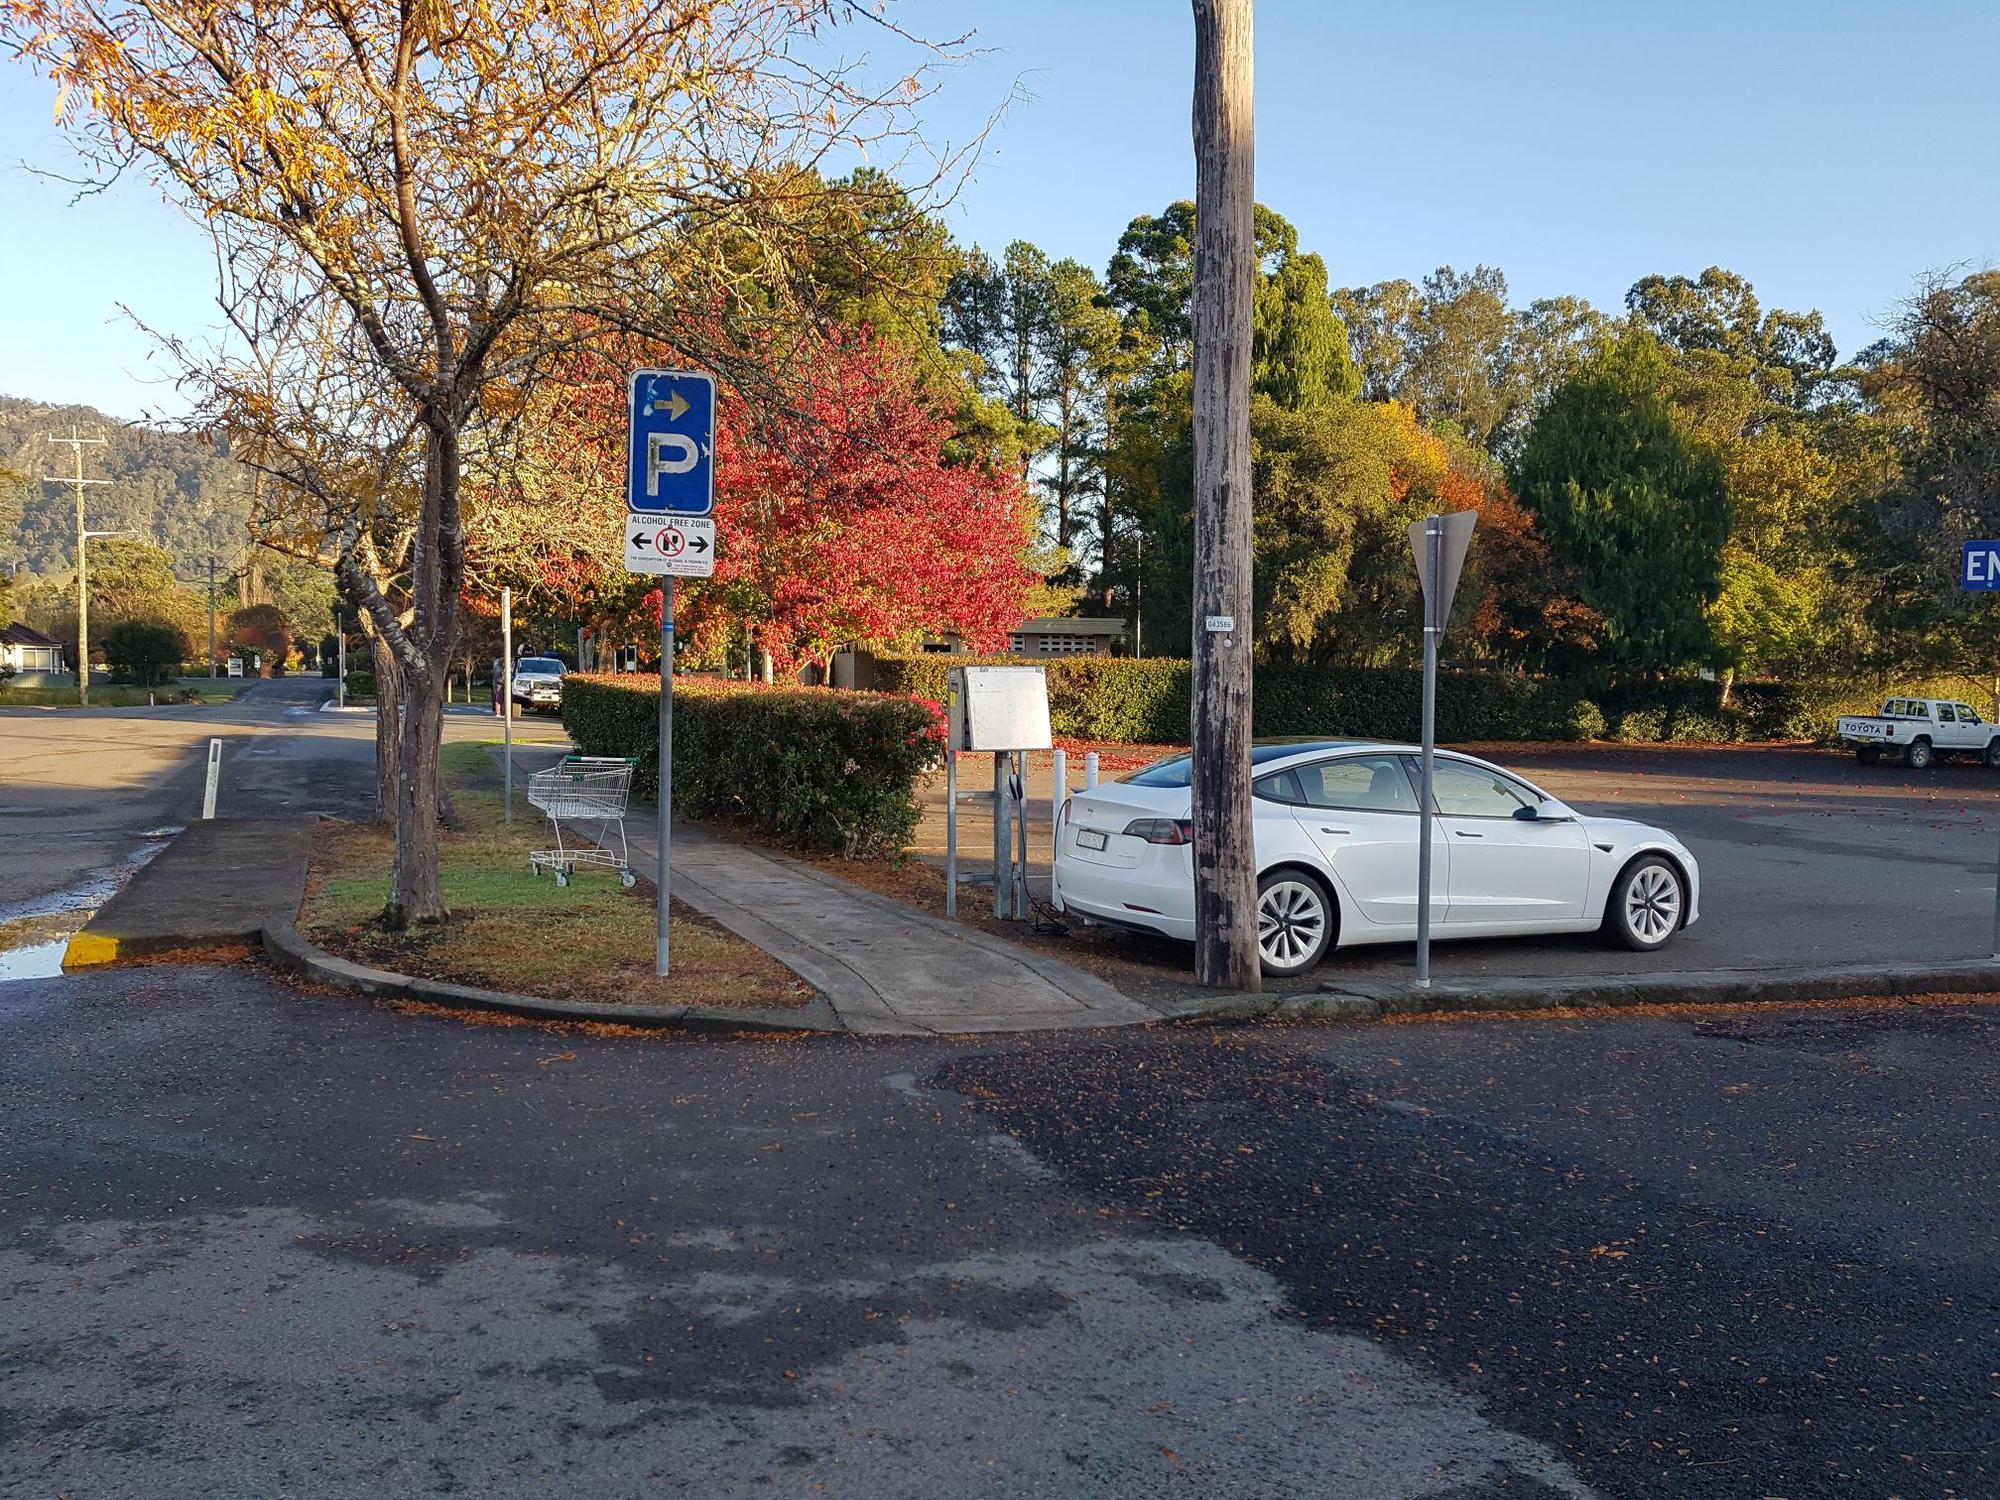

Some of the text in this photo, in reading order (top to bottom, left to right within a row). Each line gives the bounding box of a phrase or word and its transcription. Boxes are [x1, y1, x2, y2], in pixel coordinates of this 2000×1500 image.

[647, 432, 699, 497] P
[631, 516, 711, 529] ALCOHOL FREE ZONE
[1845, 723, 1881, 734] TOYOTA
